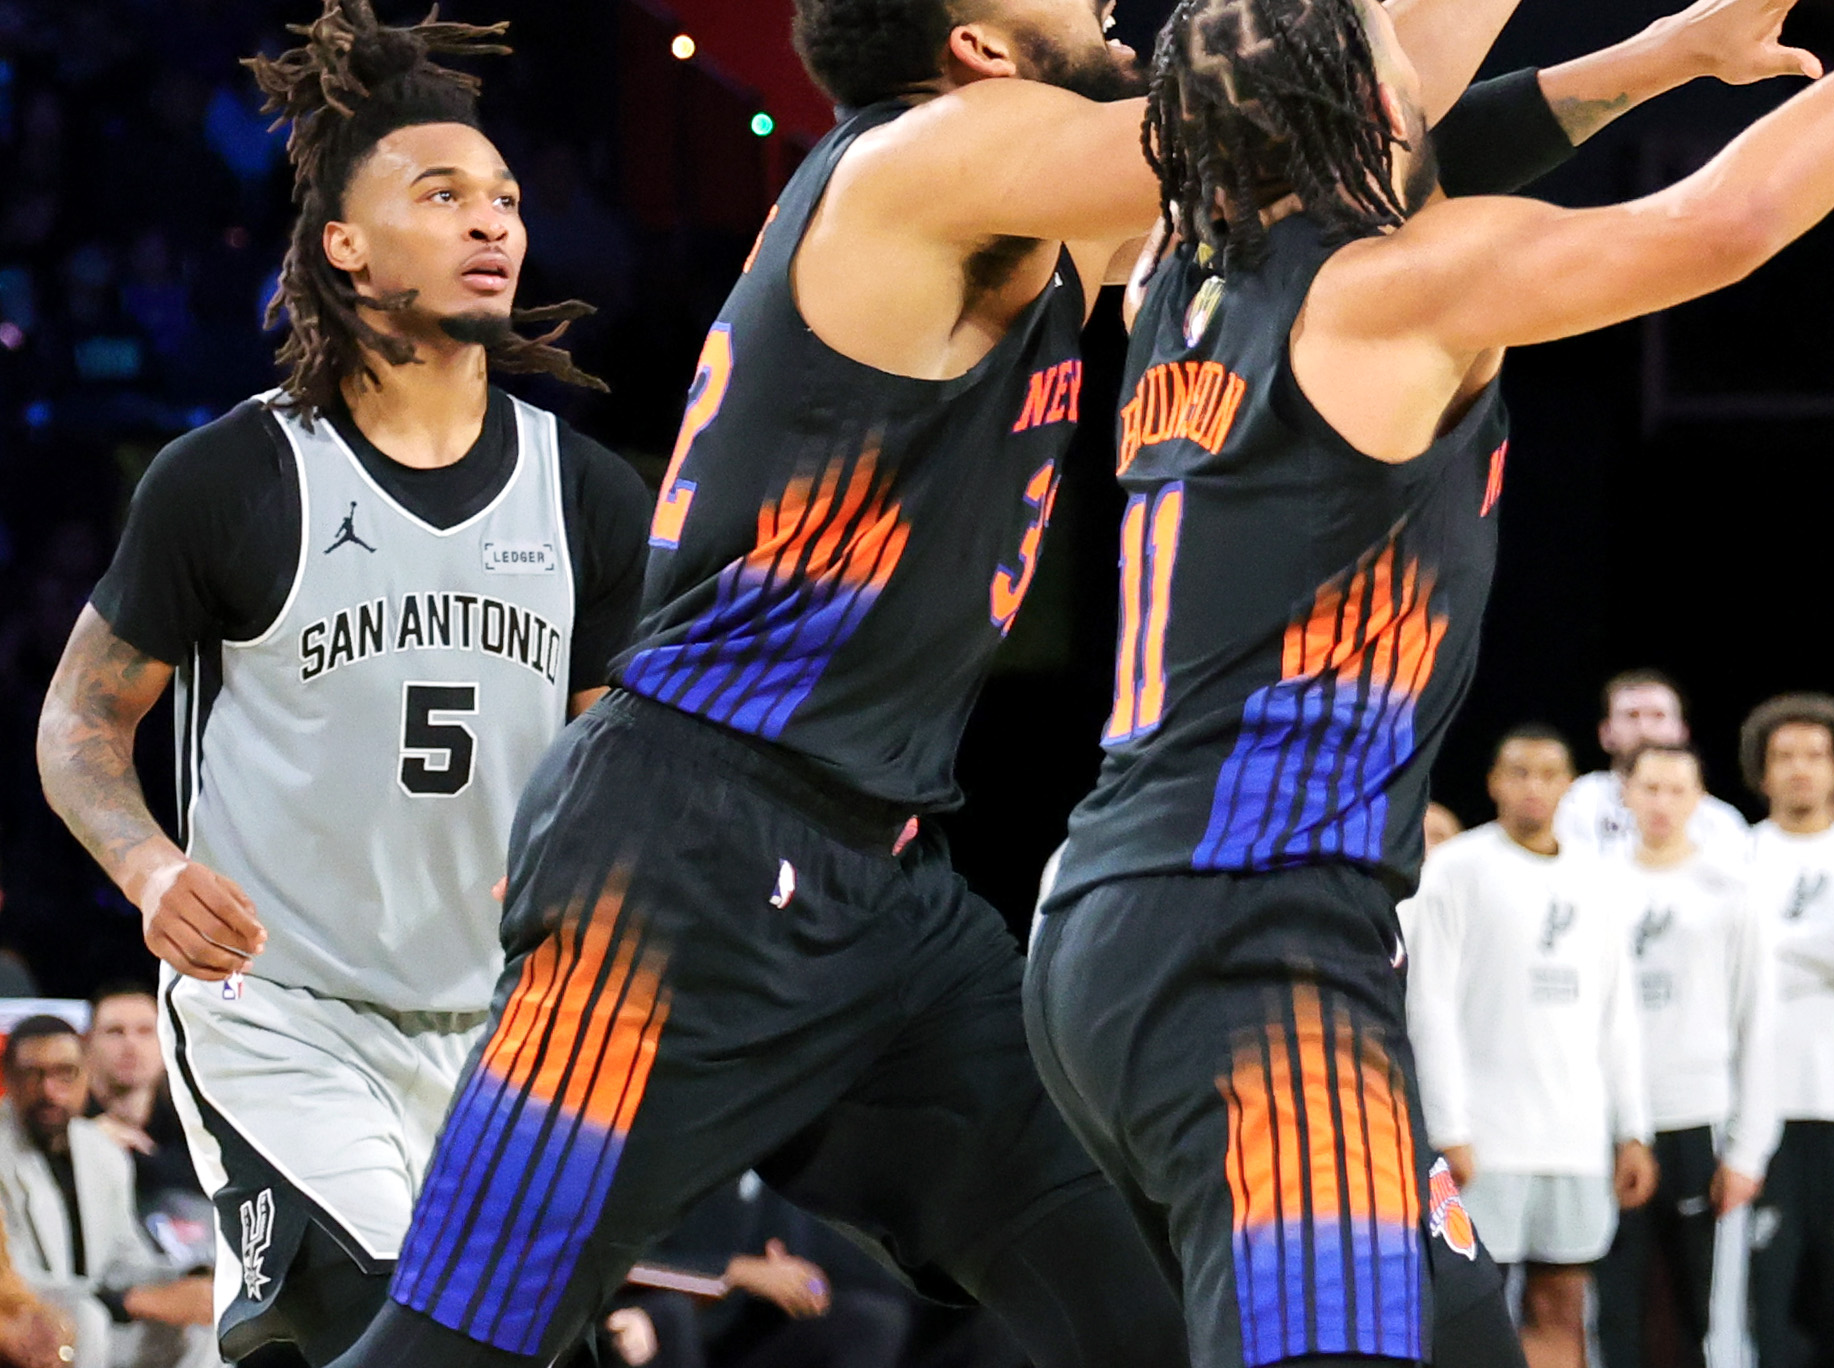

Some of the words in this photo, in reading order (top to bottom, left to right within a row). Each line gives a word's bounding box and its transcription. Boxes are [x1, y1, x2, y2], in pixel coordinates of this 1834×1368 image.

[493, 549, 546, 564] LEDGER
[300, 597, 387, 684] SAN
[396, 592, 561, 686] ANTONIO
[1099, 480, 1184, 746] 11
[397, 681, 480, 798] 5
